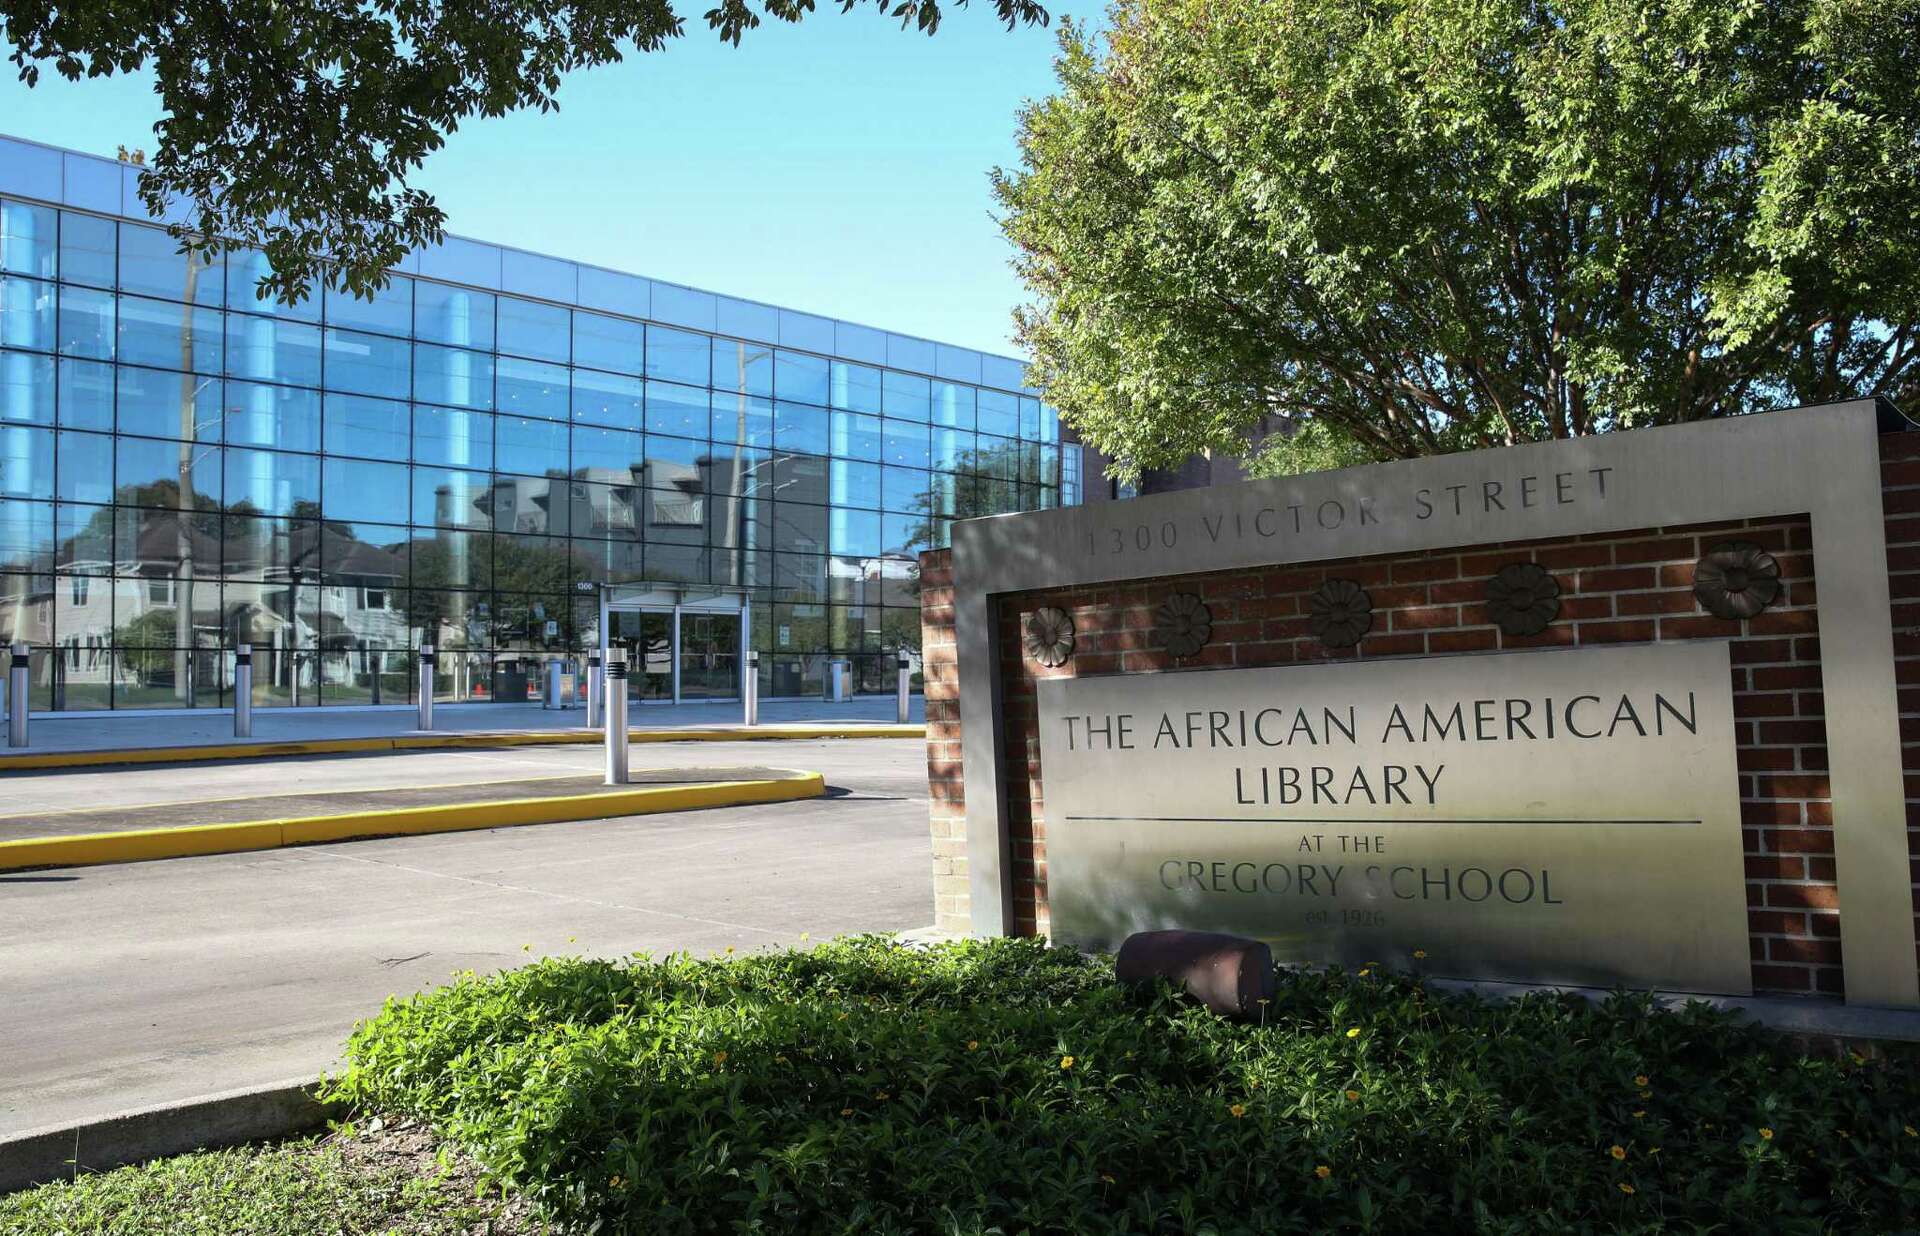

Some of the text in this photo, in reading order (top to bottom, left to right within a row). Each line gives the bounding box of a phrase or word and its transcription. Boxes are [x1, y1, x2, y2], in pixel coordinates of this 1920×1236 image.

[1089, 467, 1612, 555] 1300 VICTOR STREET
[1062, 691, 1697, 750] THE AFRICAN AMERICAN
[1235, 764, 1445, 805] LIBRARY
[1298, 836, 1385, 853] AT THE
[1158, 859, 1564, 904] GREGORY SCHOOL
[1342, 910, 1386, 928] 1926
